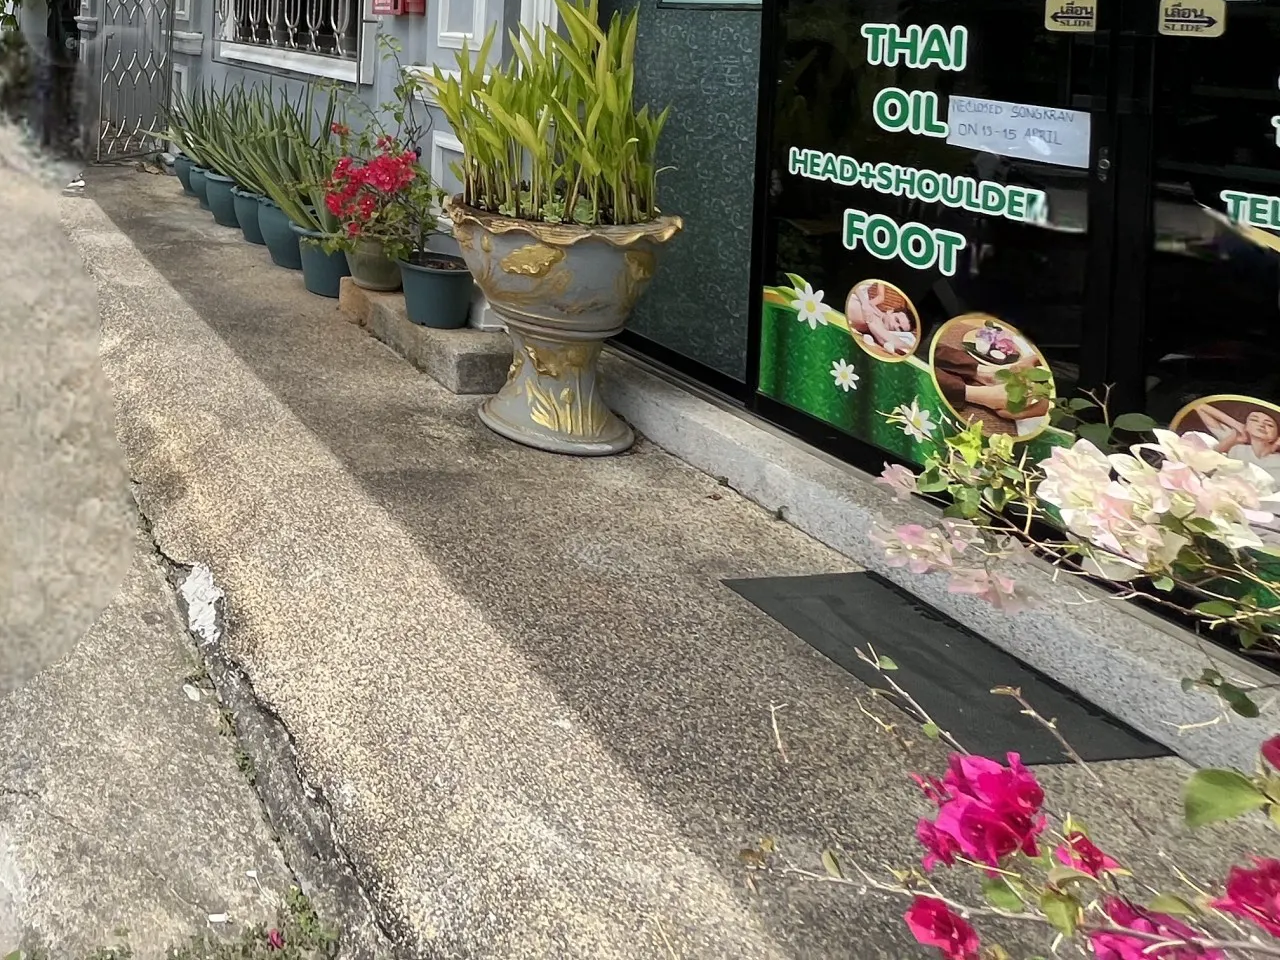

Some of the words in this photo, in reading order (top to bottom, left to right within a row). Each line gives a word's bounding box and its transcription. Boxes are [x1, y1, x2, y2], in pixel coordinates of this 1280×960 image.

[1059, 19, 1094, 28] SLIDE
[1163, 23, 1204, 33] SLIDE
[861, 23, 969, 71] THAI
[873, 86, 949, 138] OIL
[1010, 105, 1075, 123] SONGKRAN
[958, 123, 978, 137] ON
[1024, 127, 1063, 145] APRIL
[842, 208, 967, 276] FOOT
